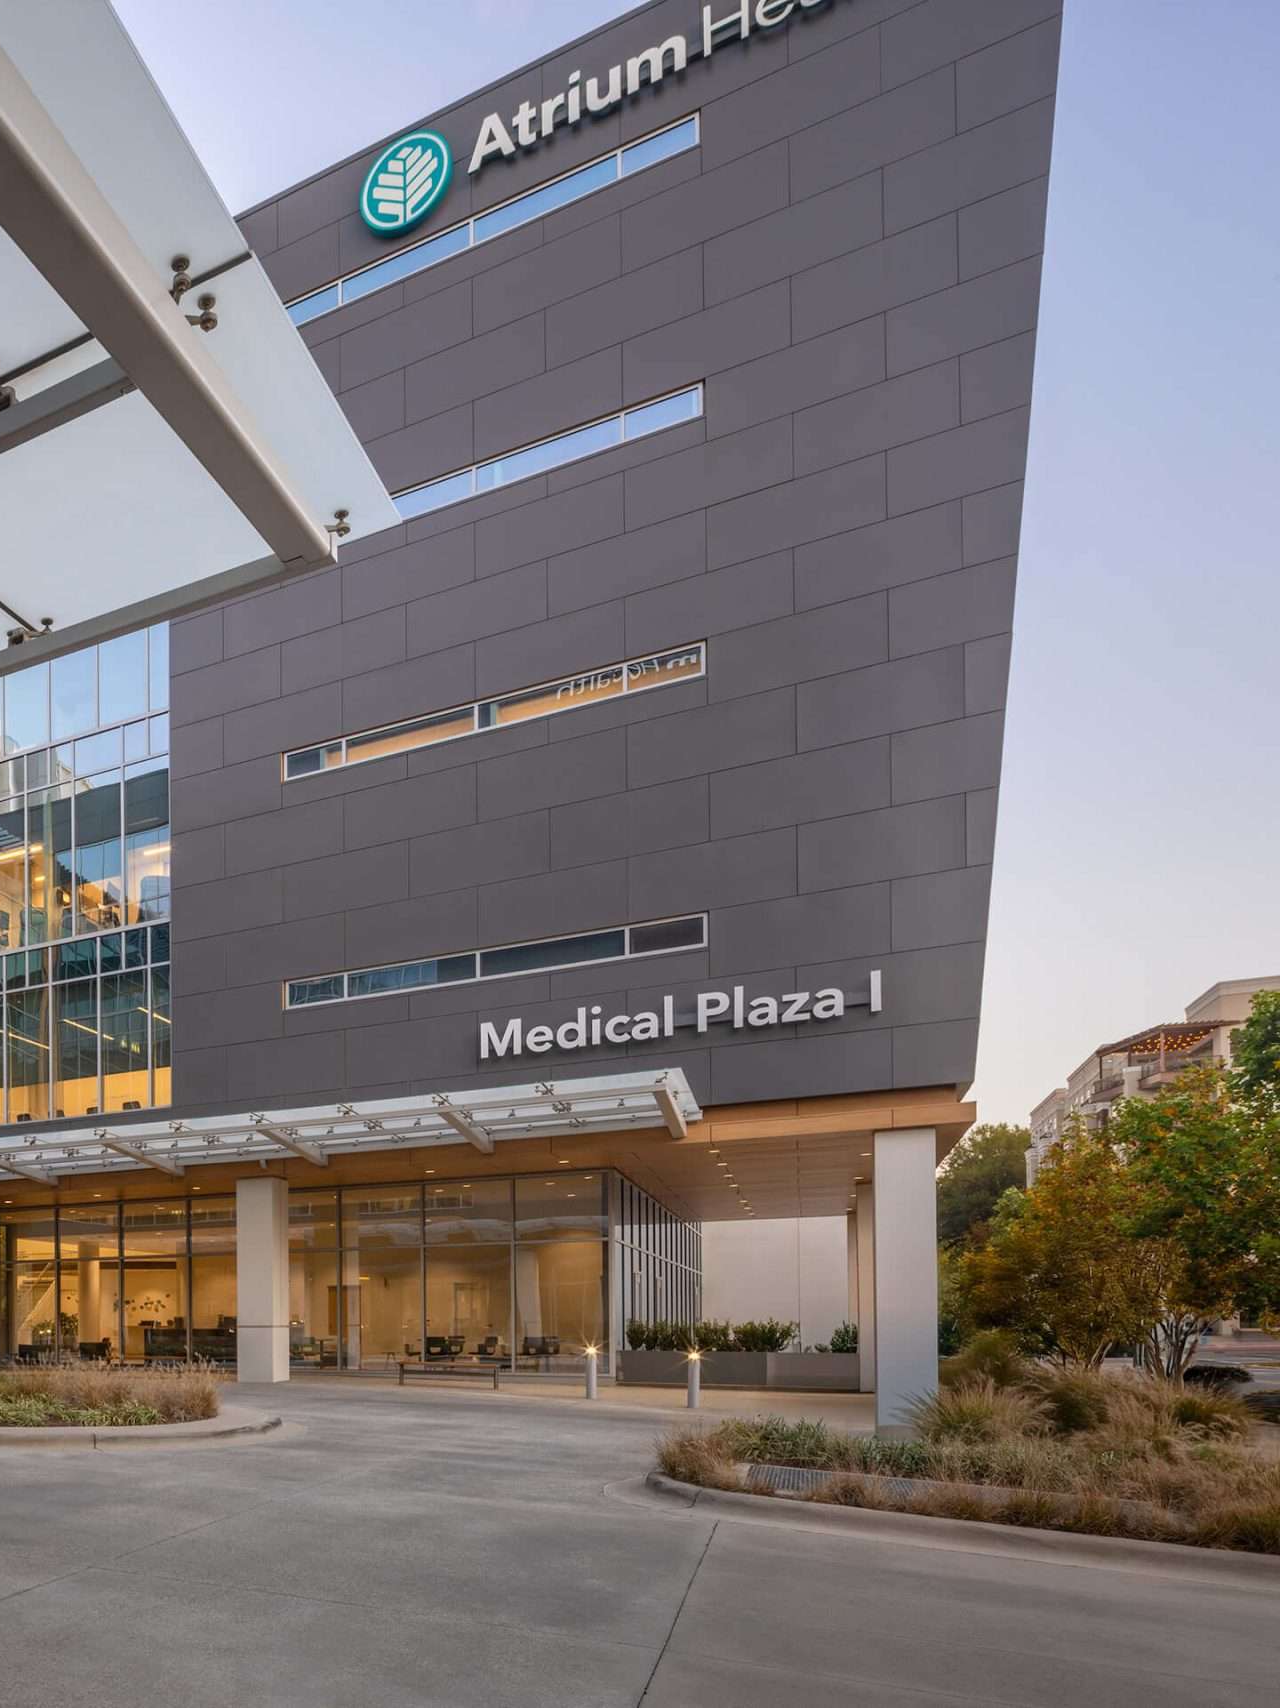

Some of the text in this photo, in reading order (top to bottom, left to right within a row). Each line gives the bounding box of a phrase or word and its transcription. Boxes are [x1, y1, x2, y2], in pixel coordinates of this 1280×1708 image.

[468, 0, 822, 174] Atrium He
[480, 970, 882, 1059] Medical Plaza I
